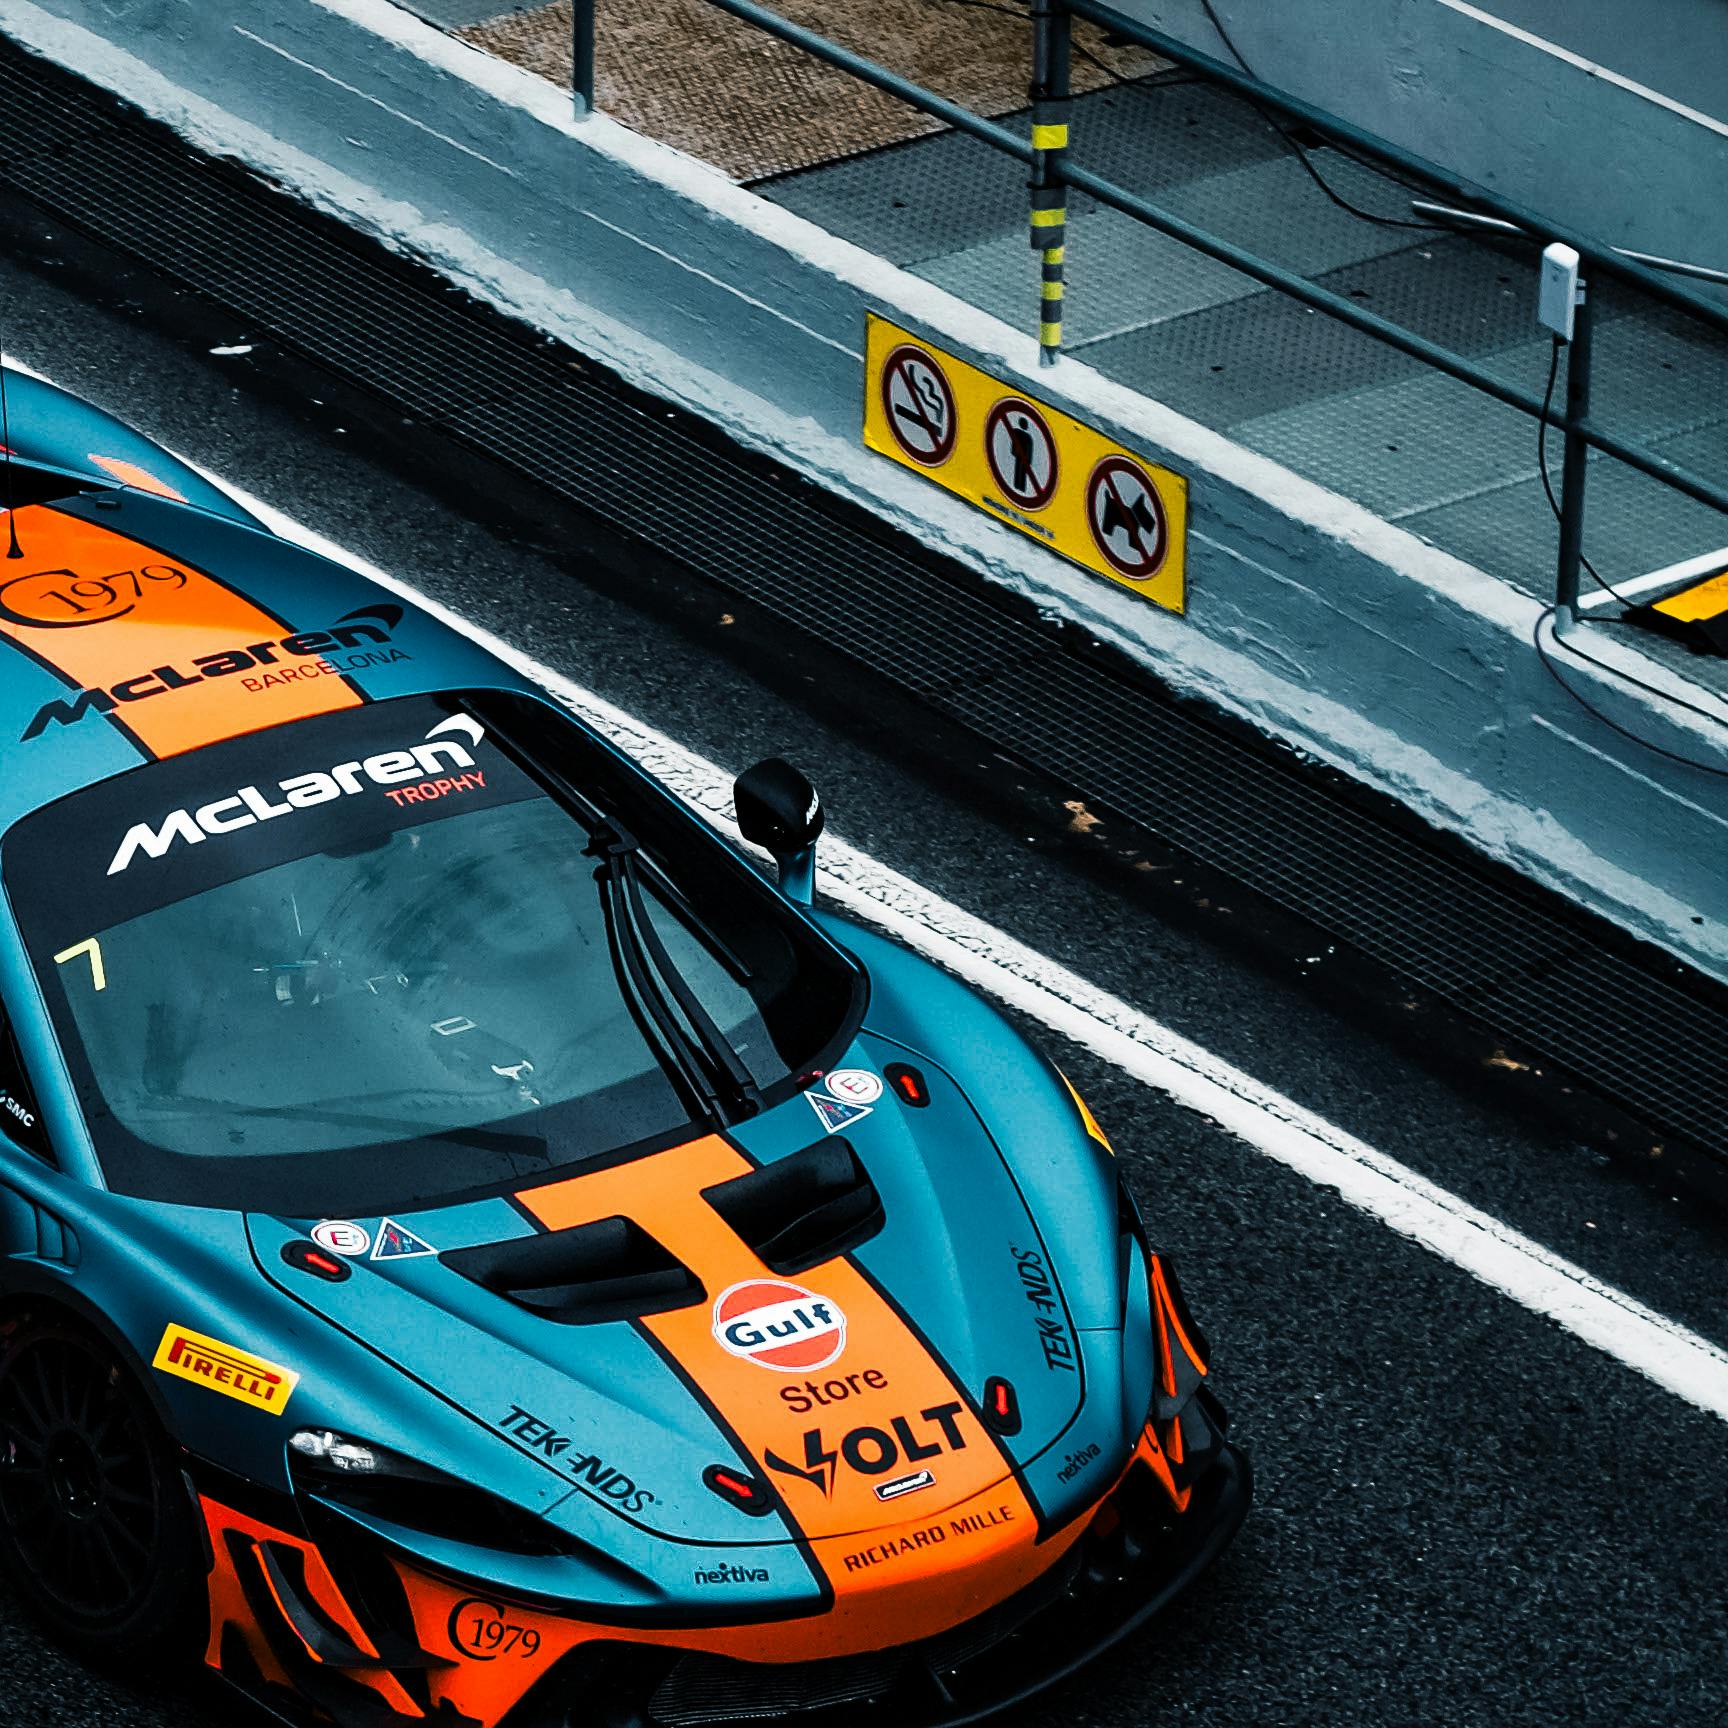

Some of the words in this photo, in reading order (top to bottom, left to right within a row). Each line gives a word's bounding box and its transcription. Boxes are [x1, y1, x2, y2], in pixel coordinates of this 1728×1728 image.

[19, 617, 394, 743] McLaren
[241, 646, 412, 693] BARCELONA
[106, 727, 478, 876] McLaren
[385, 771, 487, 808] TROPHY
[53, 937, 107, 991] 7
[6, 1097, 35, 1127] SMC
[724, 1302, 834, 1351] Gulf
[168, 1336, 282, 1402] PIRELLI
[779, 1368, 889, 1414] Store
[843, 1523, 947, 1573] RICHARD
[951, 1504, 1016, 1537] MILLE
[694, 1561, 770, 1585] nextiva
